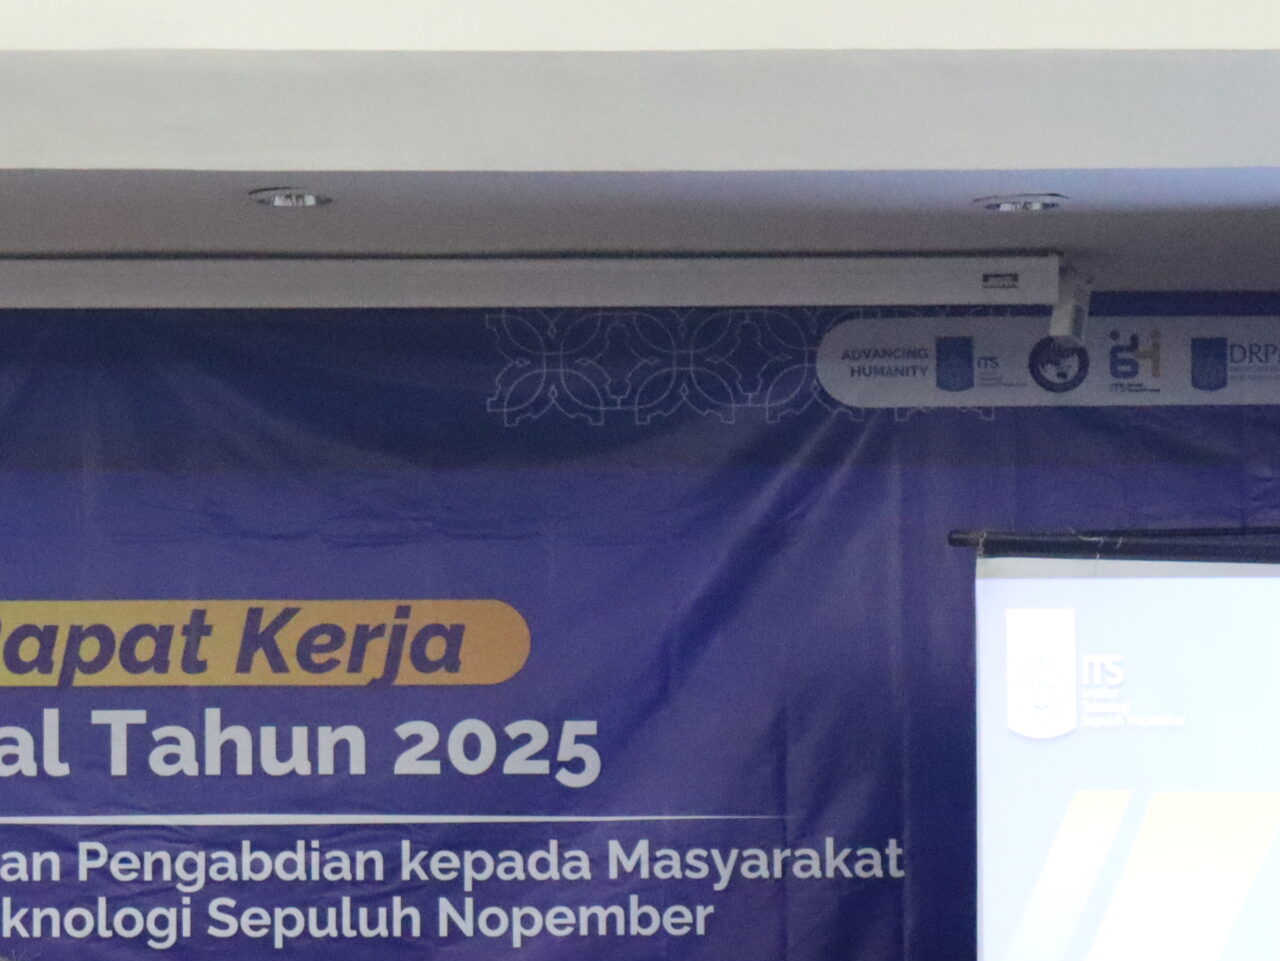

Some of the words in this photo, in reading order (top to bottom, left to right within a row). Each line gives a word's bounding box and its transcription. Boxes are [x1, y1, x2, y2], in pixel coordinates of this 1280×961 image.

[841, 347, 929, 361] ADVANCING
[977, 356, 1000, 369] ITS
[1230, 343, 1280, 364] DRP
[850, 365, 929, 377] HUMANITY
[236, 605, 467, 686] Kerja
[1081, 654, 1125, 686] ITS
[91, 707, 366, 777] Tahun
[393, 718, 601, 788] 2025
[78, 839, 384, 893] Pengabdian
[401, 839, 592, 892] kepada
[608, 837, 904, 891] Masyarakat
[207, 895, 421, 949] Sepuluh
[438, 894, 714, 948] Nopember
